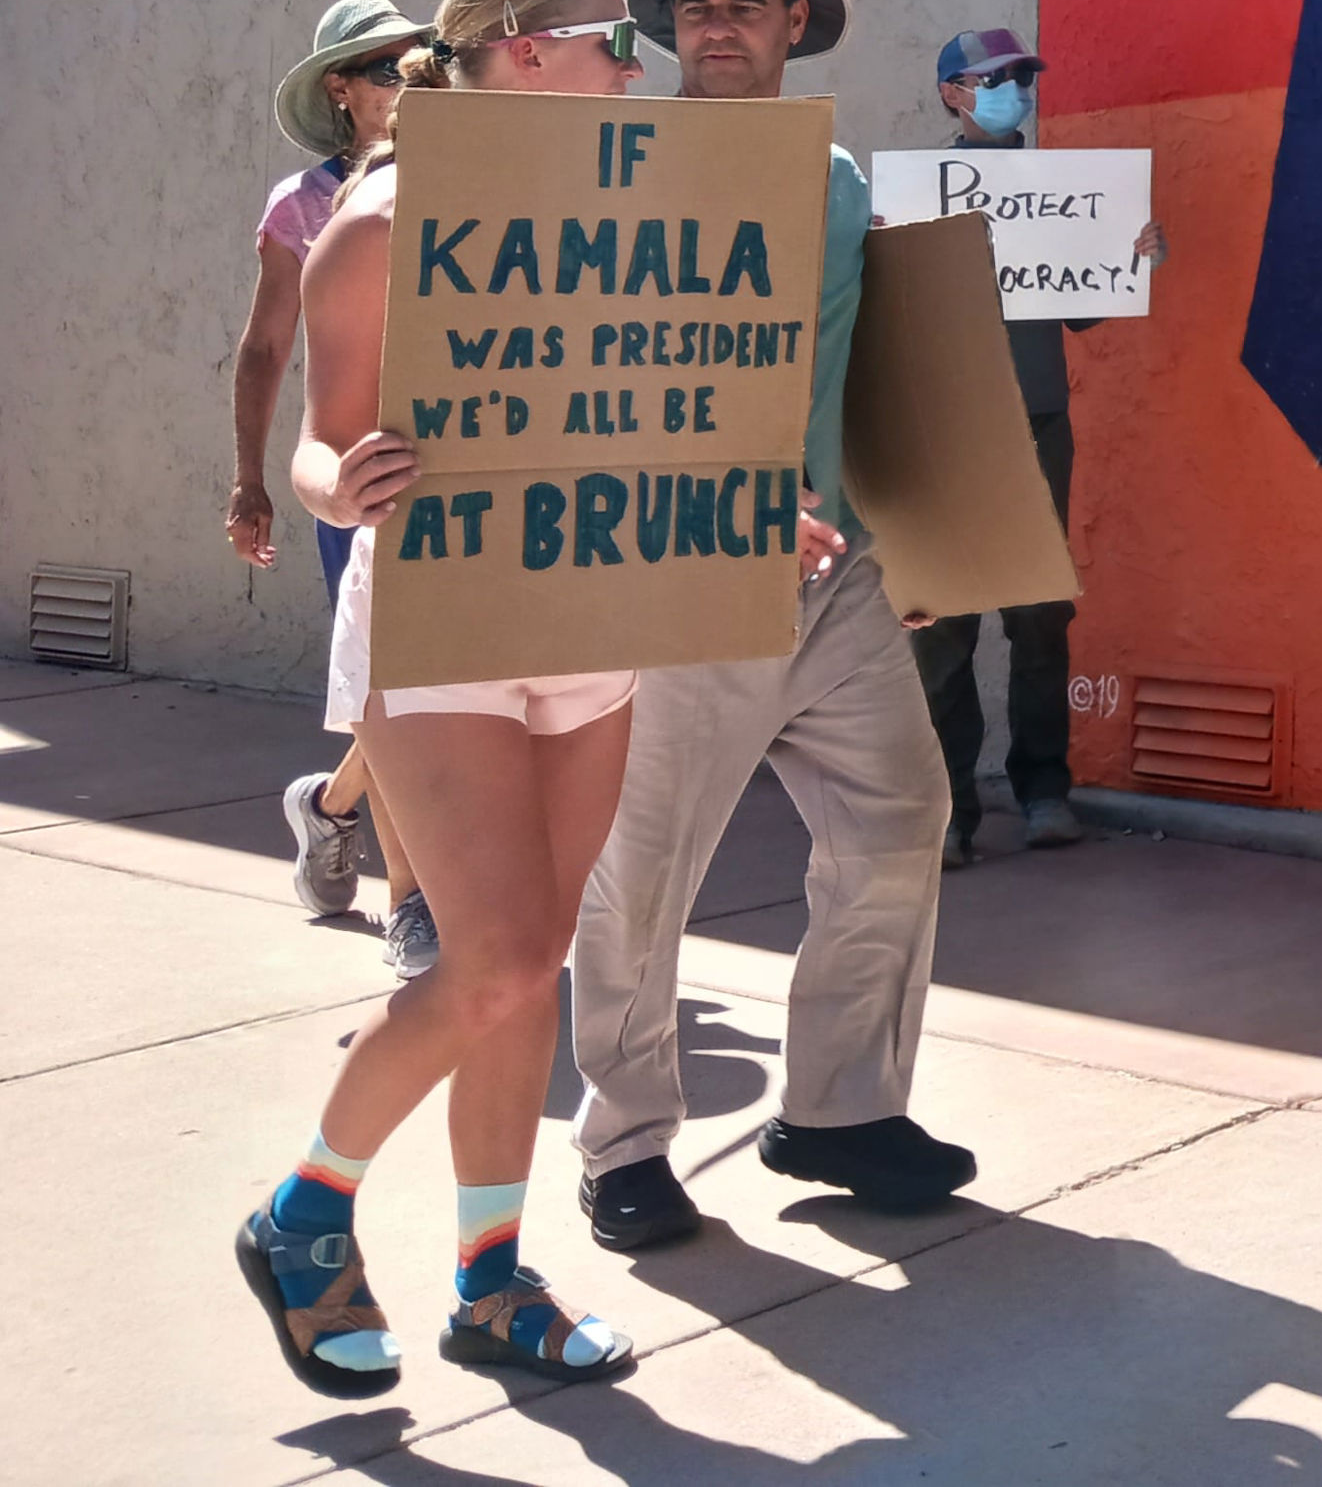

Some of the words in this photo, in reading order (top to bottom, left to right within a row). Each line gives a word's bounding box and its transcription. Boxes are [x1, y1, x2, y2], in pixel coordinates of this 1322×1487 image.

[597, 121, 655, 189] IF
[939, 160, 1106, 224] PROTECT
[416, 217, 773, 298] KAMALA
[999, 251, 1141, 294] OCRACY!
[446, 325, 565, 371] WAS
[591, 320, 804, 369] PRESIDENT
[411, 389, 530, 441] WE'D
[563, 389, 639, 438] ALL
[663, 385, 718, 434] BE
[397, 490, 493, 562] AT
[521, 466, 798, 572] BRUNCH
